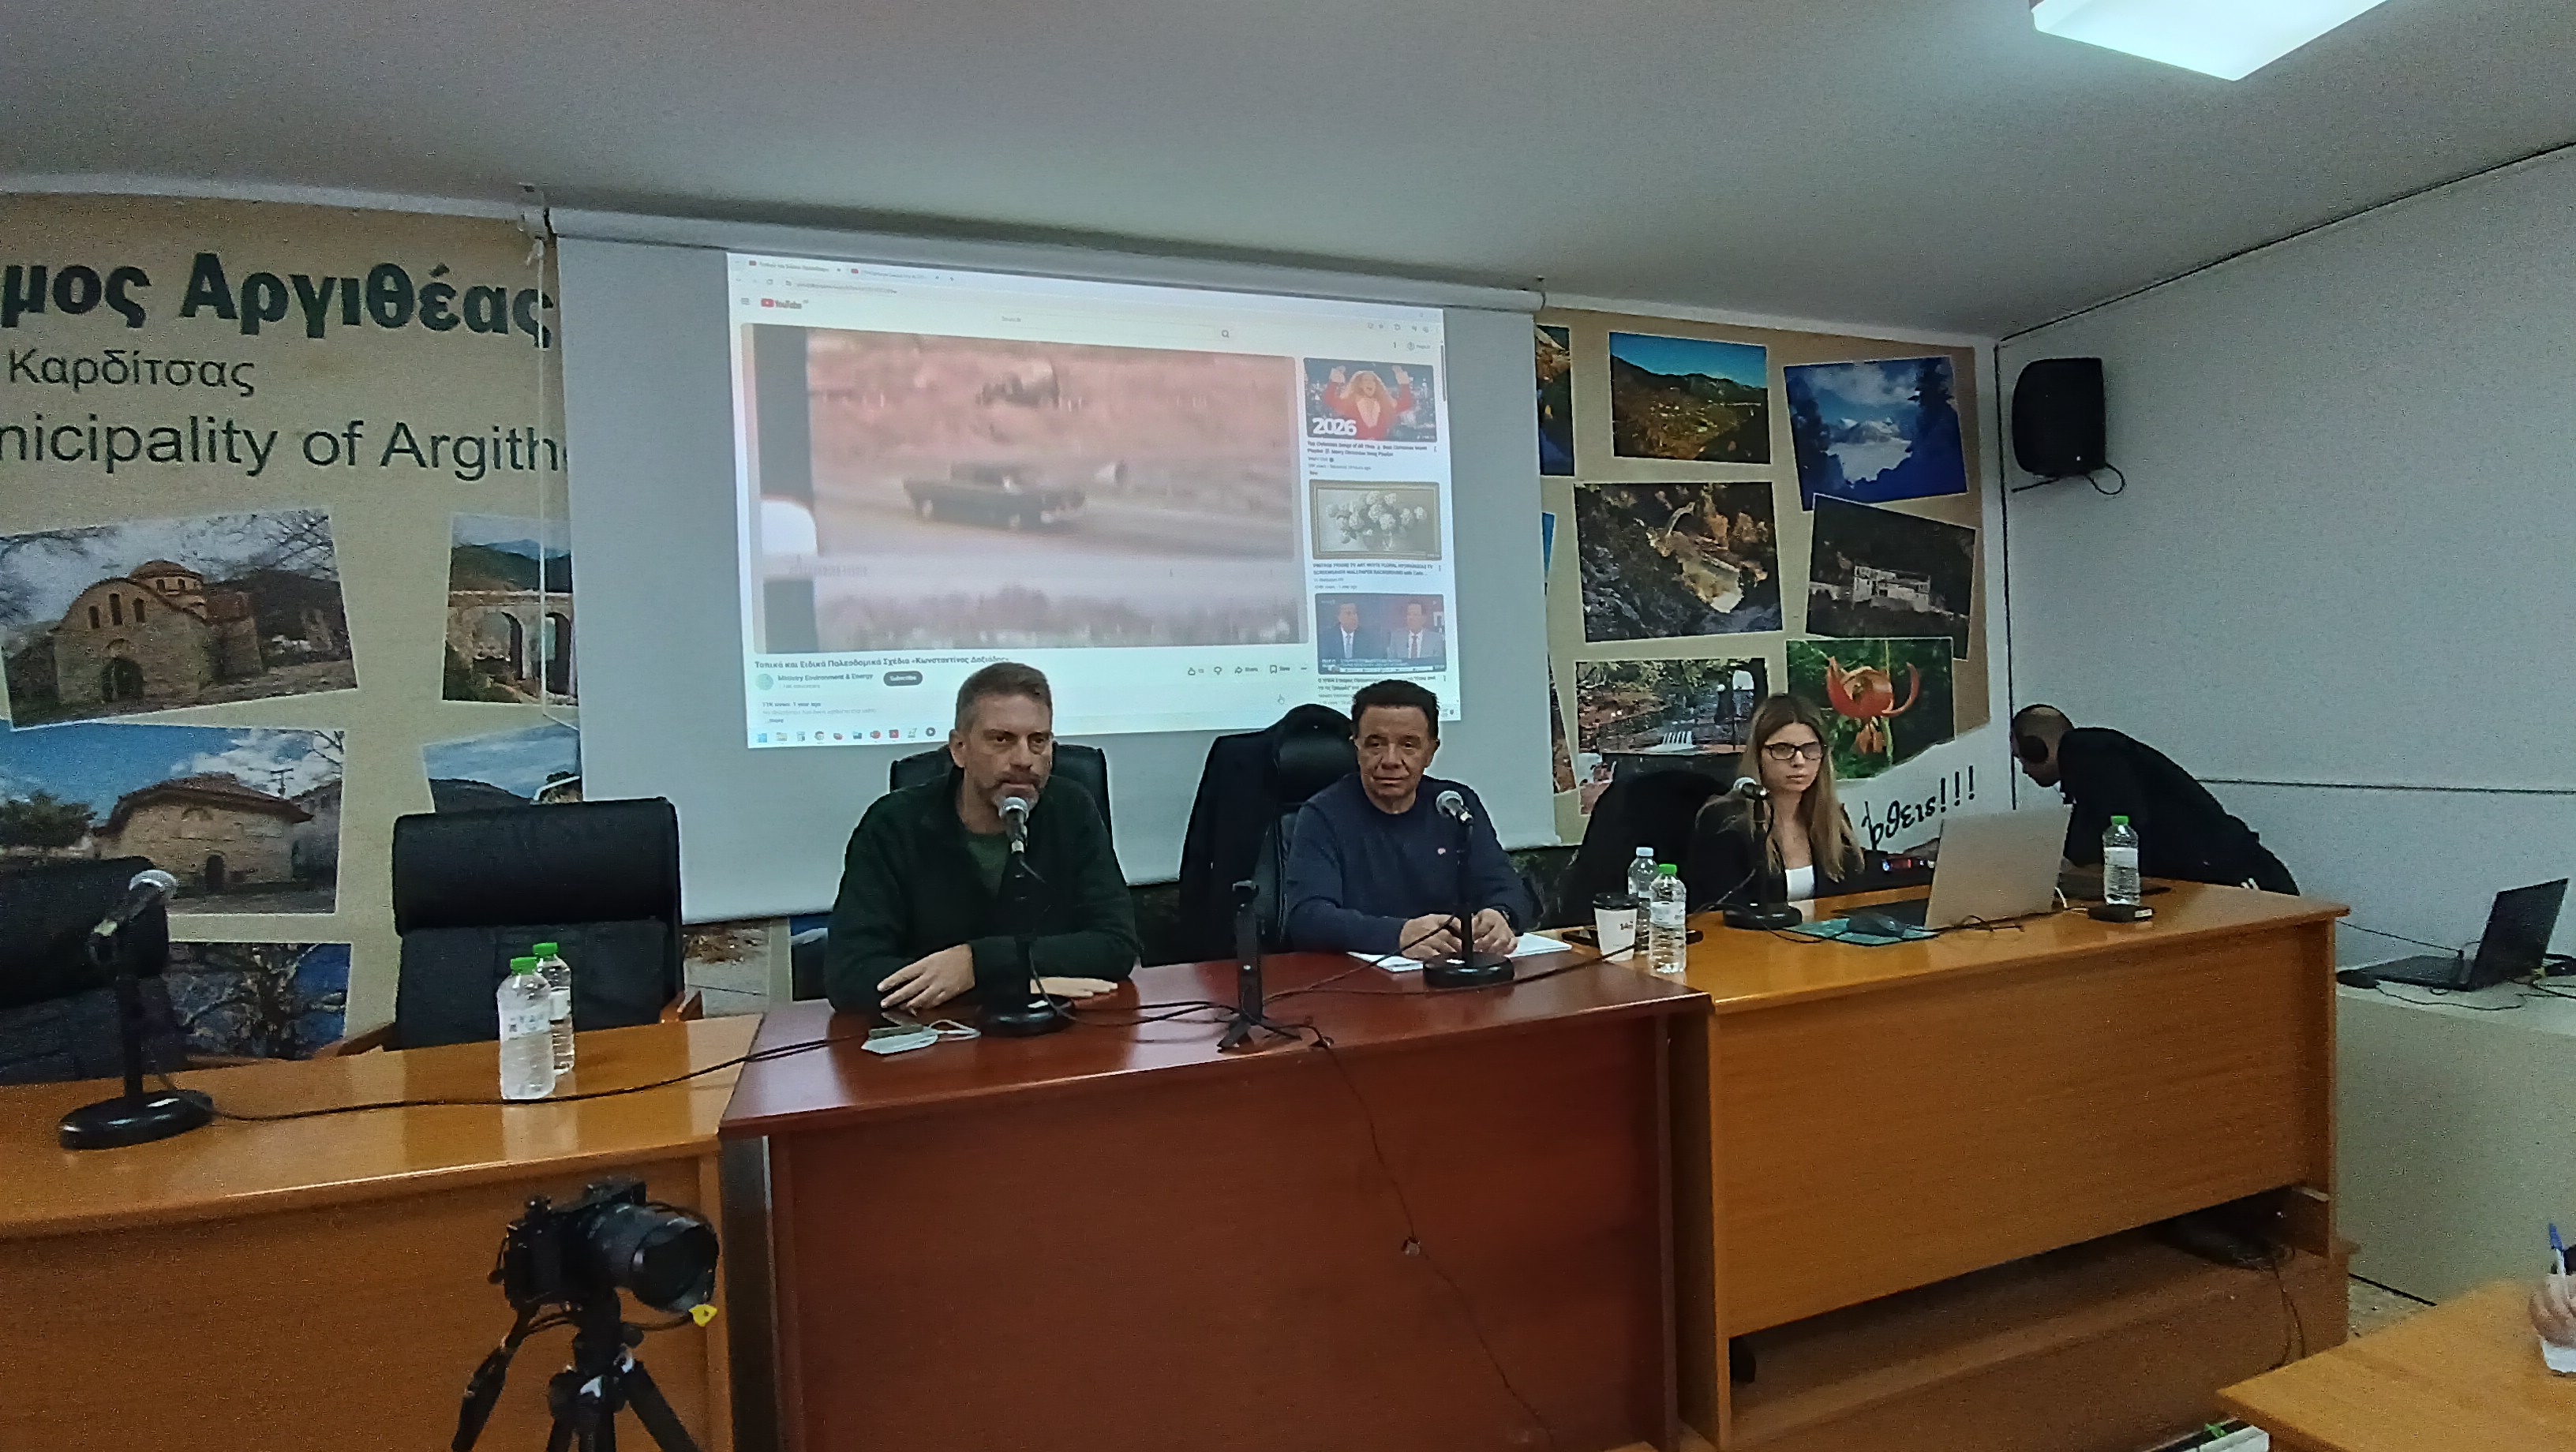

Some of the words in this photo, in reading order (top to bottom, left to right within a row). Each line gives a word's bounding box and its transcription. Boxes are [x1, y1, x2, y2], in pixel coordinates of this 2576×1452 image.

[1, 264, 151, 328] μος
[179, 252, 555, 349] Αργιθέας
[8, 348, 255, 397] Καρδίτσας
[303, 419, 365, 467] of
[380, 421, 567, 482] Argith
[1312, 417, 1358, 436] 2026
